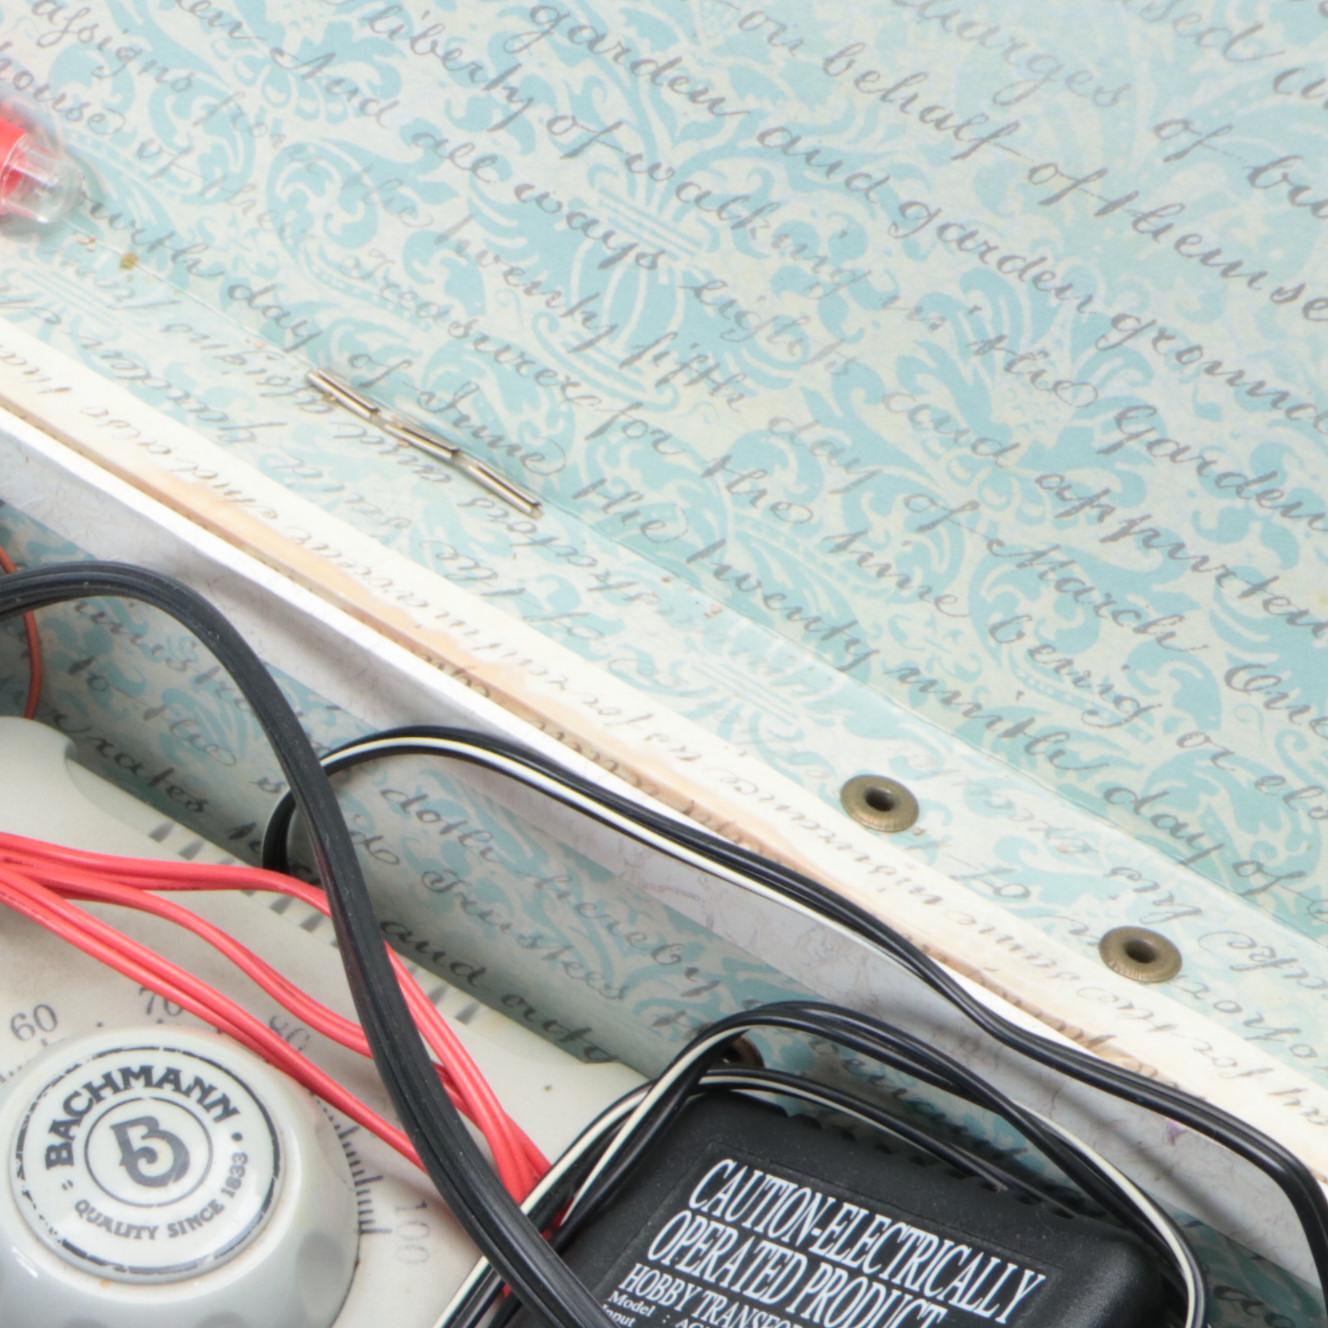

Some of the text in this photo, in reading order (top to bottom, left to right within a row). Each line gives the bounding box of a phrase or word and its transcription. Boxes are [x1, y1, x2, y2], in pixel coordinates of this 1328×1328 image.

[10, 1003, 59, 1043] 60
[44, 1064, 242, 1171] BACHMANN
[74, 1150, 249, 1241] QUALITY SINCE 1833
[618, 1262, 705, 1313] HOBBY
[645, 1209, 810, 1316] OPERATED
[687, 1157, 1047, 1327] CAUTION-ELECTRICALLY
[607, 1289, 657, 1319] Model
